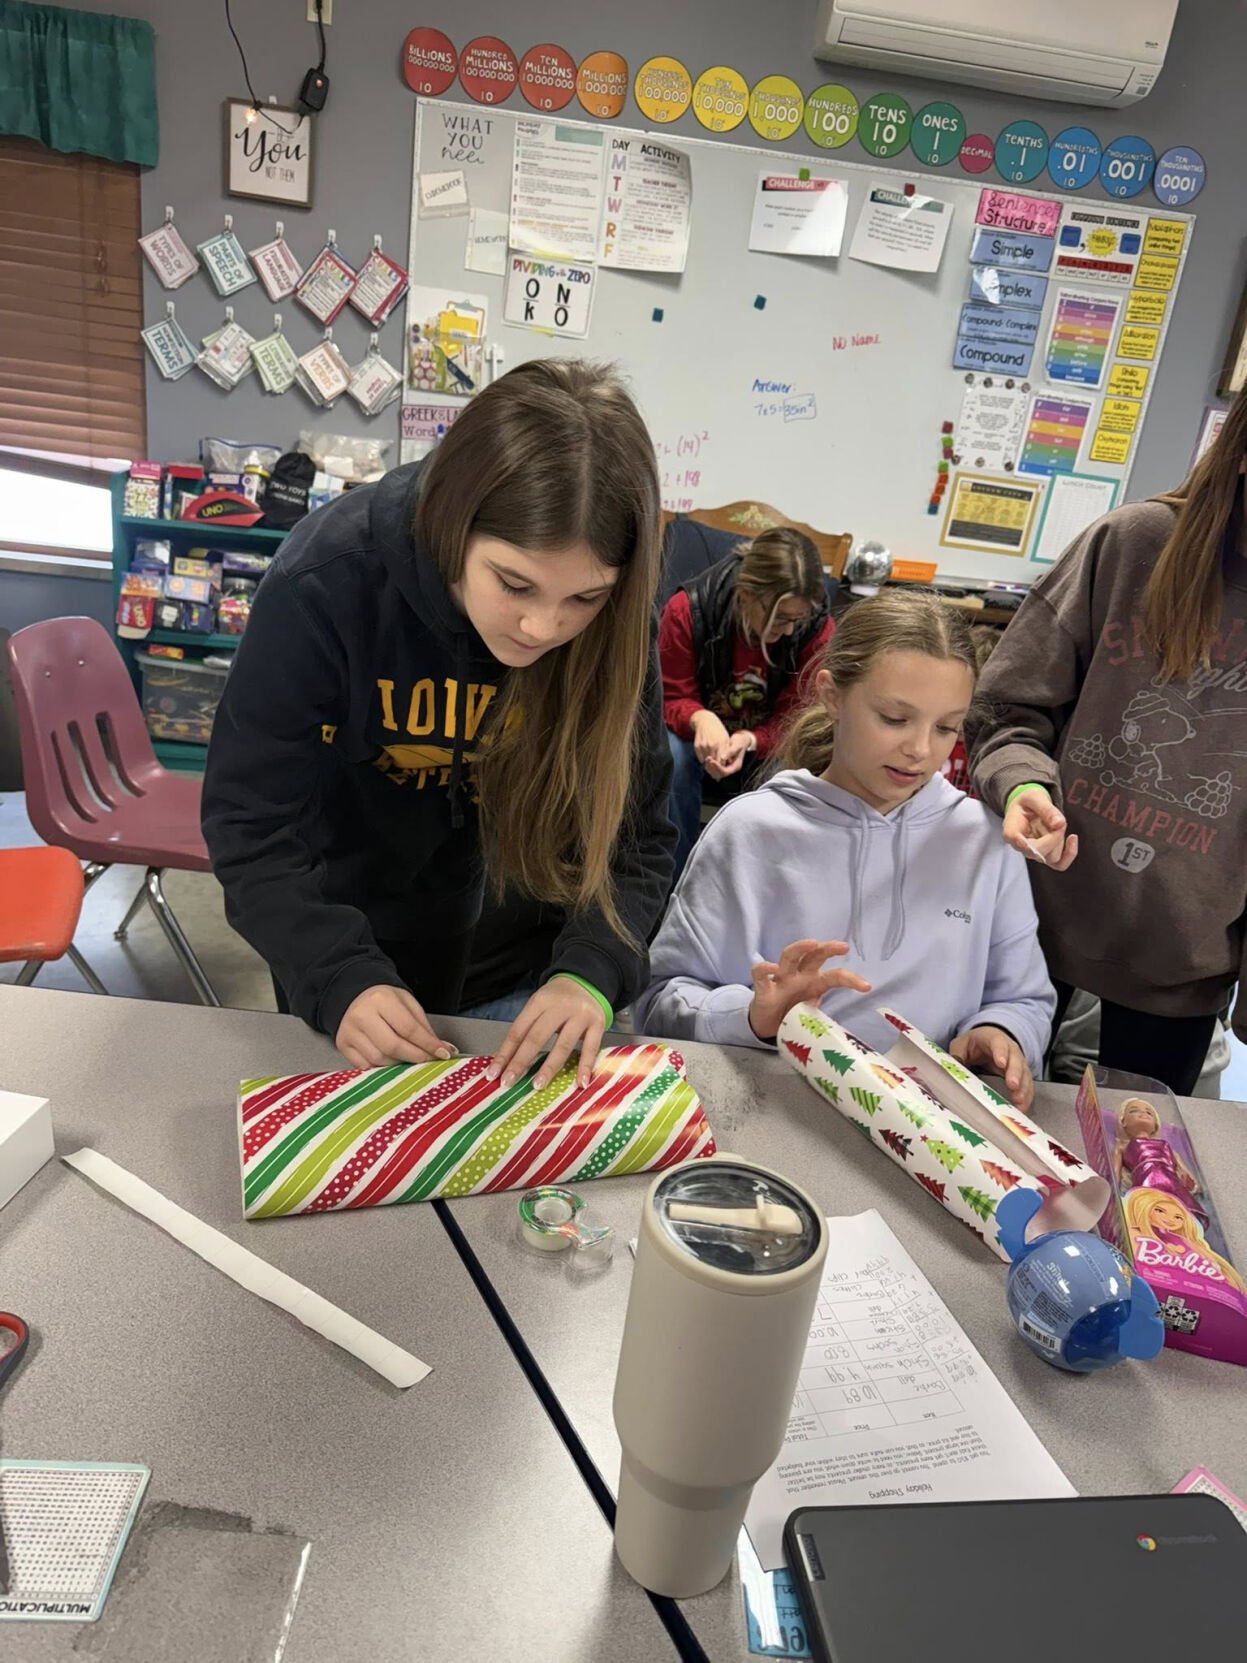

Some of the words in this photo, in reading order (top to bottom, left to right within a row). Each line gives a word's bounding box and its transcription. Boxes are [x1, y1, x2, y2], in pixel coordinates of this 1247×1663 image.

[409, 45, 452, 63] BILLIONS
[540, 56, 558, 66] TEN
[466, 56, 513, 72] MILLIONS
[525, 61, 572, 79] MILLIONS
[582, 69, 627, 83] MILLIONS
[808, 98, 857, 116] HUNDREDS
[442, 113, 494, 134] WHAT
[812, 112, 849, 134] 100
[872, 122, 896, 142] 10
[235, 127, 306, 172] You
[448, 132, 483, 150] YOU
[1005, 133, 1043, 148] TENTHS
[612, 139, 630, 149] DAY
[641, 144, 681, 163] ACTIVITY
[611, 154, 626, 171] M
[613, 176, 621, 192] T
[608, 198, 622, 213] W
[984, 209, 1047, 232] Structure
[606, 222, 616, 238] R
[604, 244, 613, 257] F
[991, 240, 1034, 259] Simple
[207, 244, 237, 287] SPEECH
[567, 268, 591, 284] ZERO
[150, 330, 179, 370] TERMS
[960, 344, 1025, 366] Compound
[257, 346, 286, 386] TERMS
[402, 407, 437, 421] GREEK
[202, 504, 224, 517] UNO
[376, 677, 497, 741] IOW
[1066, 778, 1217, 854] CHAMPION
[1117, 842, 1152, 867] 1ST
[1135, 1237, 1225, 1280] Barbie
[869, 1487, 904, 1499] Shopping
[905, 1484, 932, 1495] Holiday
[0, 1602, 90, 1614] MULTIPLICATIO
